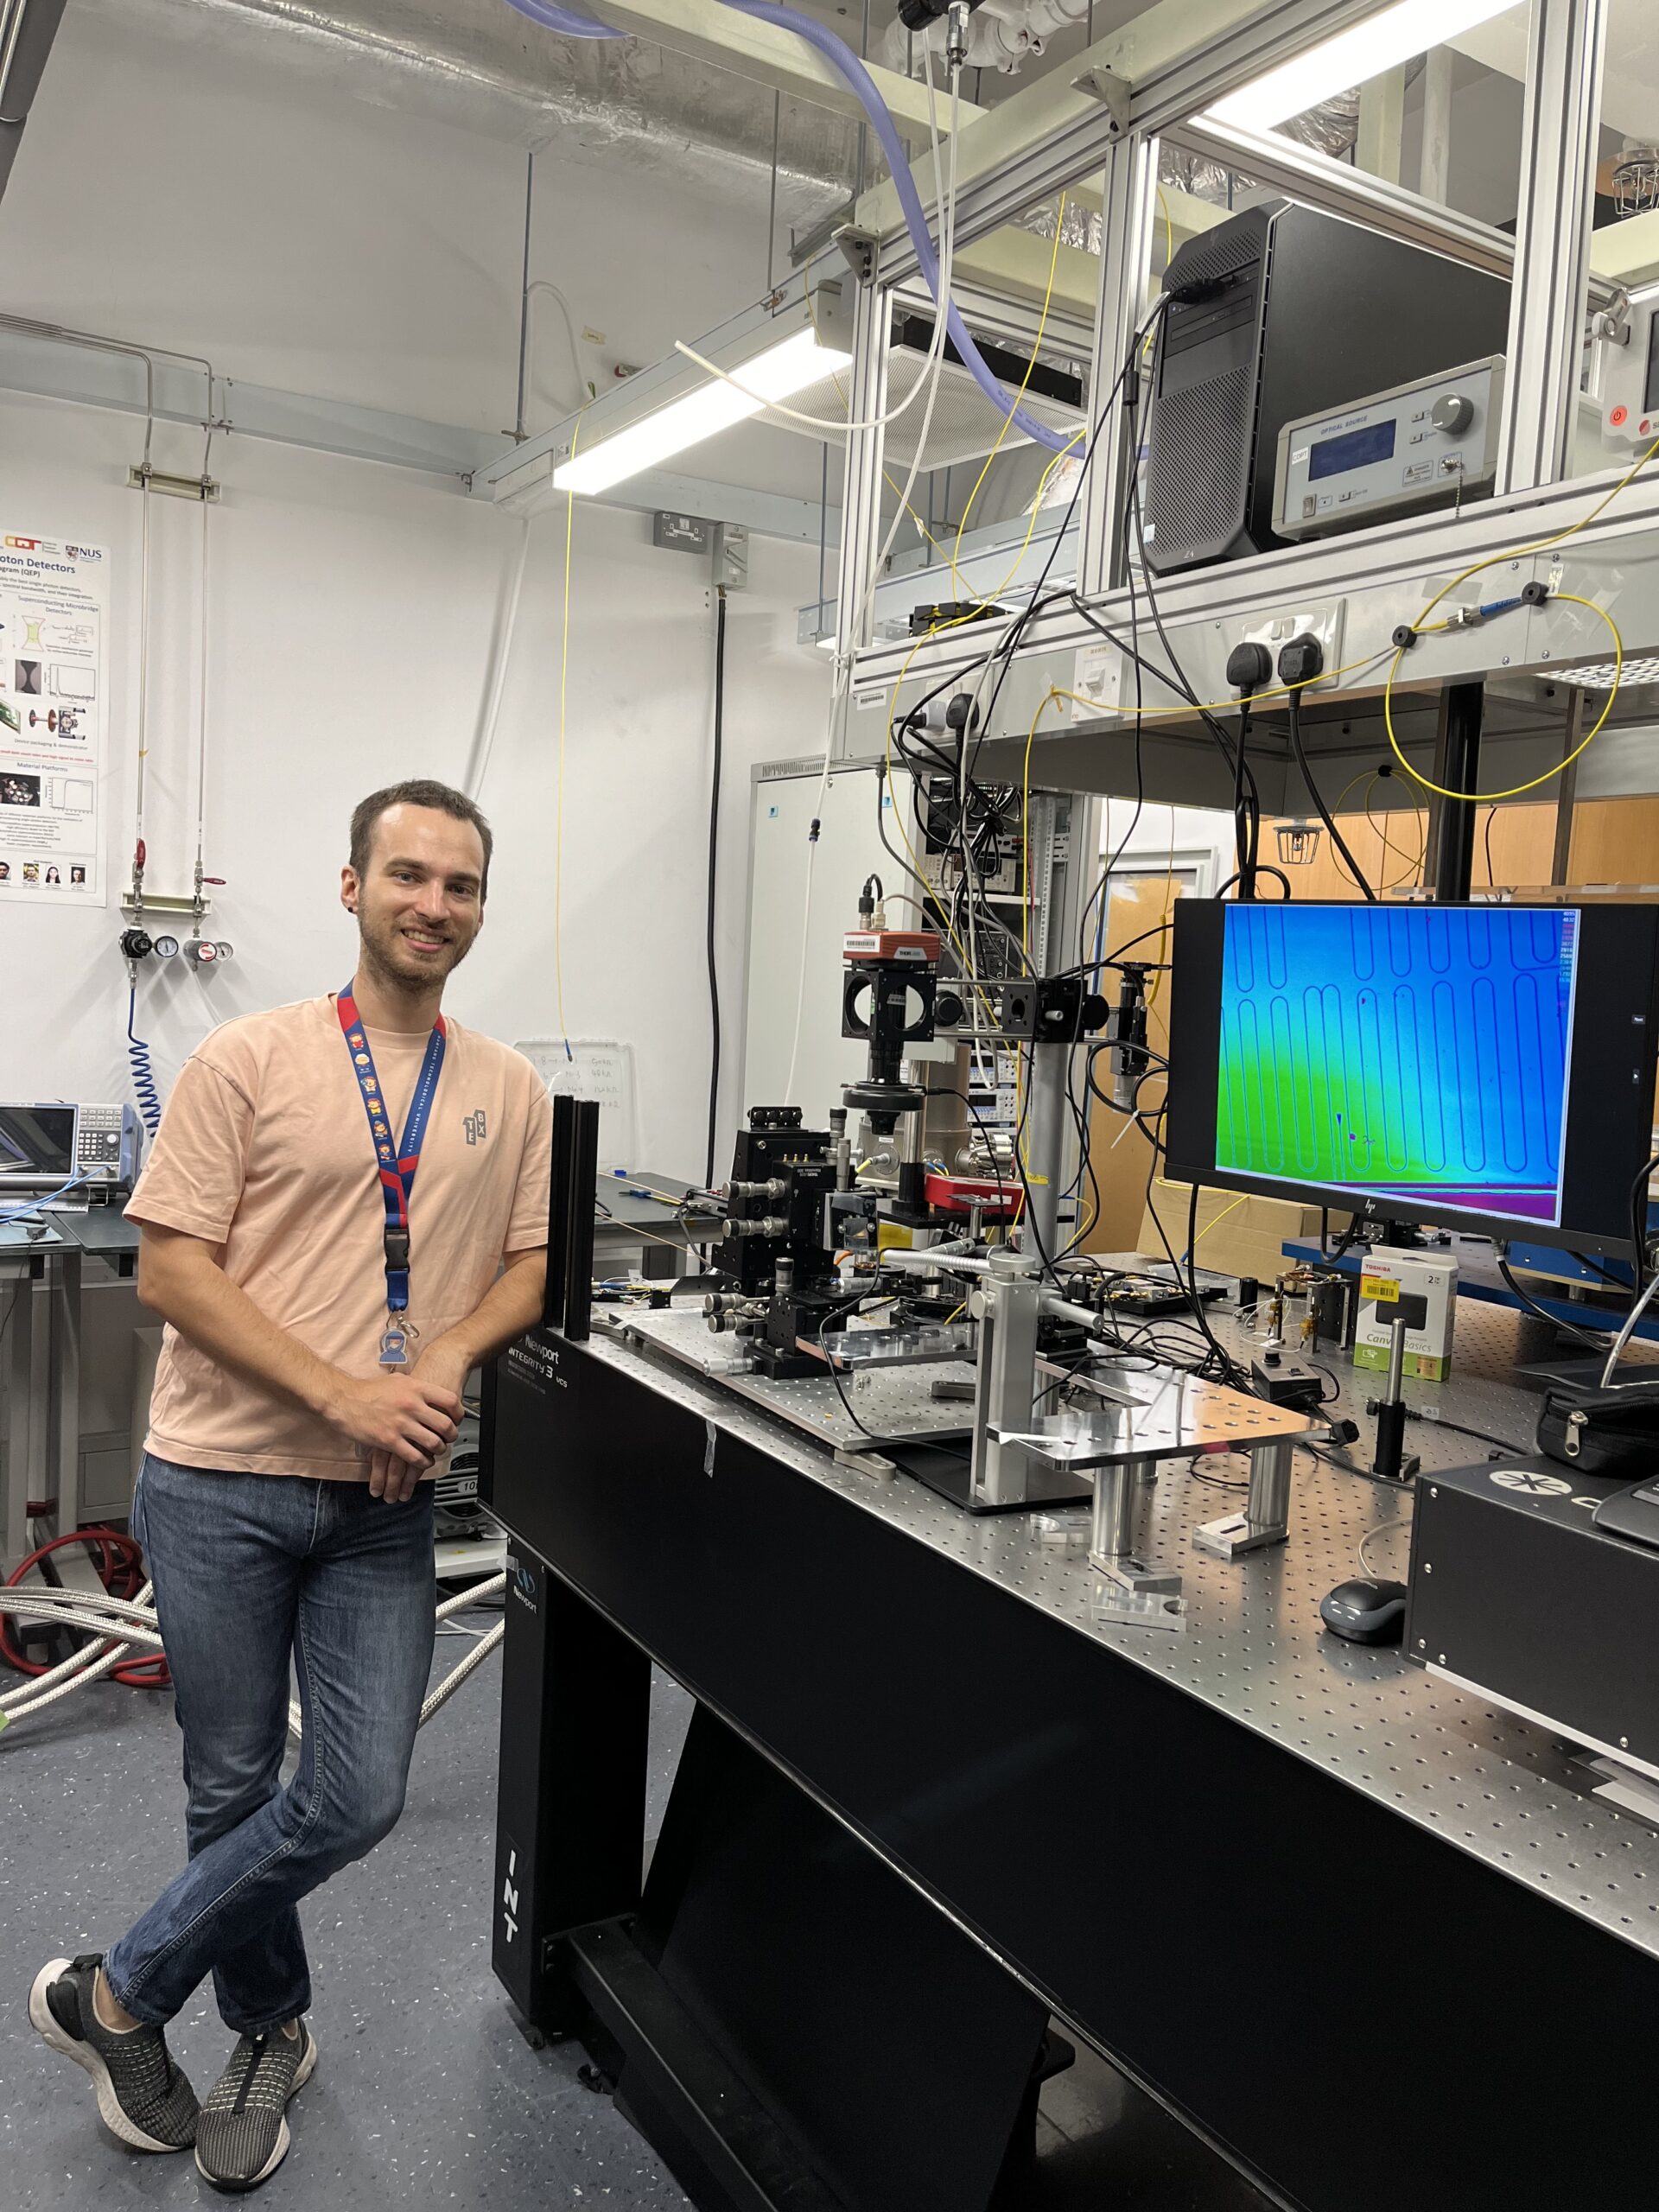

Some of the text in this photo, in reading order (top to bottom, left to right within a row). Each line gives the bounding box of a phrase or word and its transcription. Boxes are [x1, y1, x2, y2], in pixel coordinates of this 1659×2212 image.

[1320, 416, 1368, 435] OPTICAL SOURCE
[79, 547, 102, 559] NUS
[21, 568, 41, 578] (QEP)
[27, 558, 76, 574] Detectors
[18, 594, 99, 613] Superconducting Microbridge
[46, 607, 73, 616] Detectors
[41, 765, 68, 773] Platforms
[418, 1063, 435, 1110] TECHNOLOGICAL
[407, 1113, 422, 1153] UNIVERSITY
[1365, 1263, 1391, 1273] TOSHIBA
[1427, 1275, 1434, 1284] 2
[1366, 1332, 1392, 1345] Canv
[524, 1333, 560, 1364] Newport
[508, 1346, 545, 1374] INTEGRITY
[545, 1365, 554, 1379] 3
[513, 1584, 537, 1614] Newport
